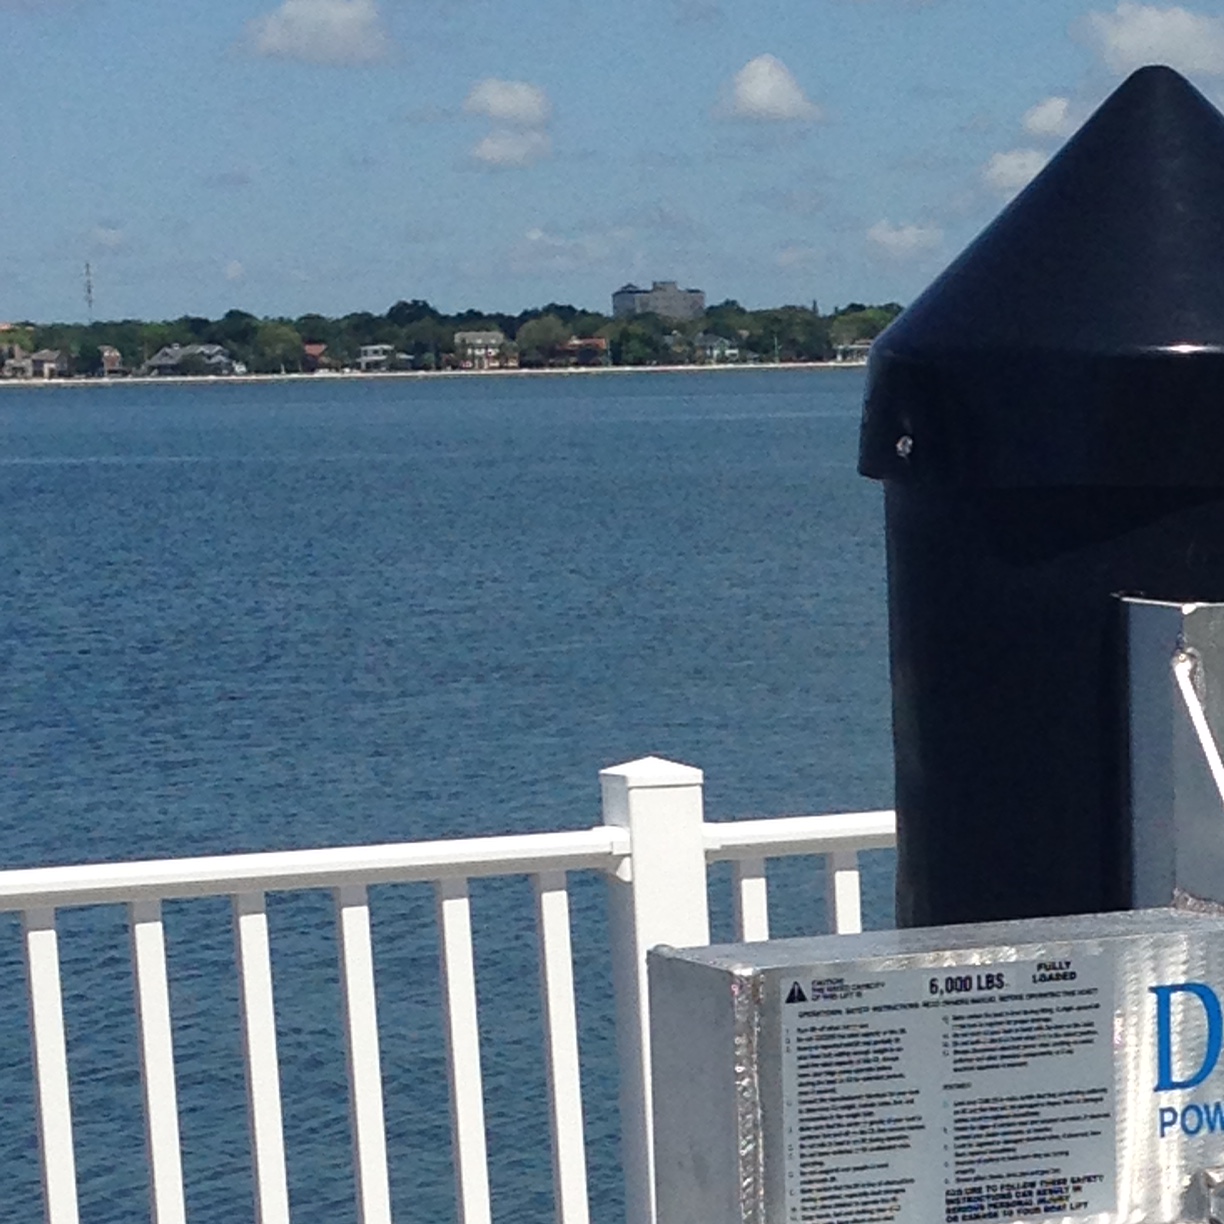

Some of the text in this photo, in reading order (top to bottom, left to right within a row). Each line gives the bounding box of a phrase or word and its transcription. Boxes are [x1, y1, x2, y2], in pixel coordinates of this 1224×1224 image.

[1037, 961, 1071, 972] FULLY
[1032, 971, 1077, 984] LOADED
[929, 976, 972, 996] 6,000
